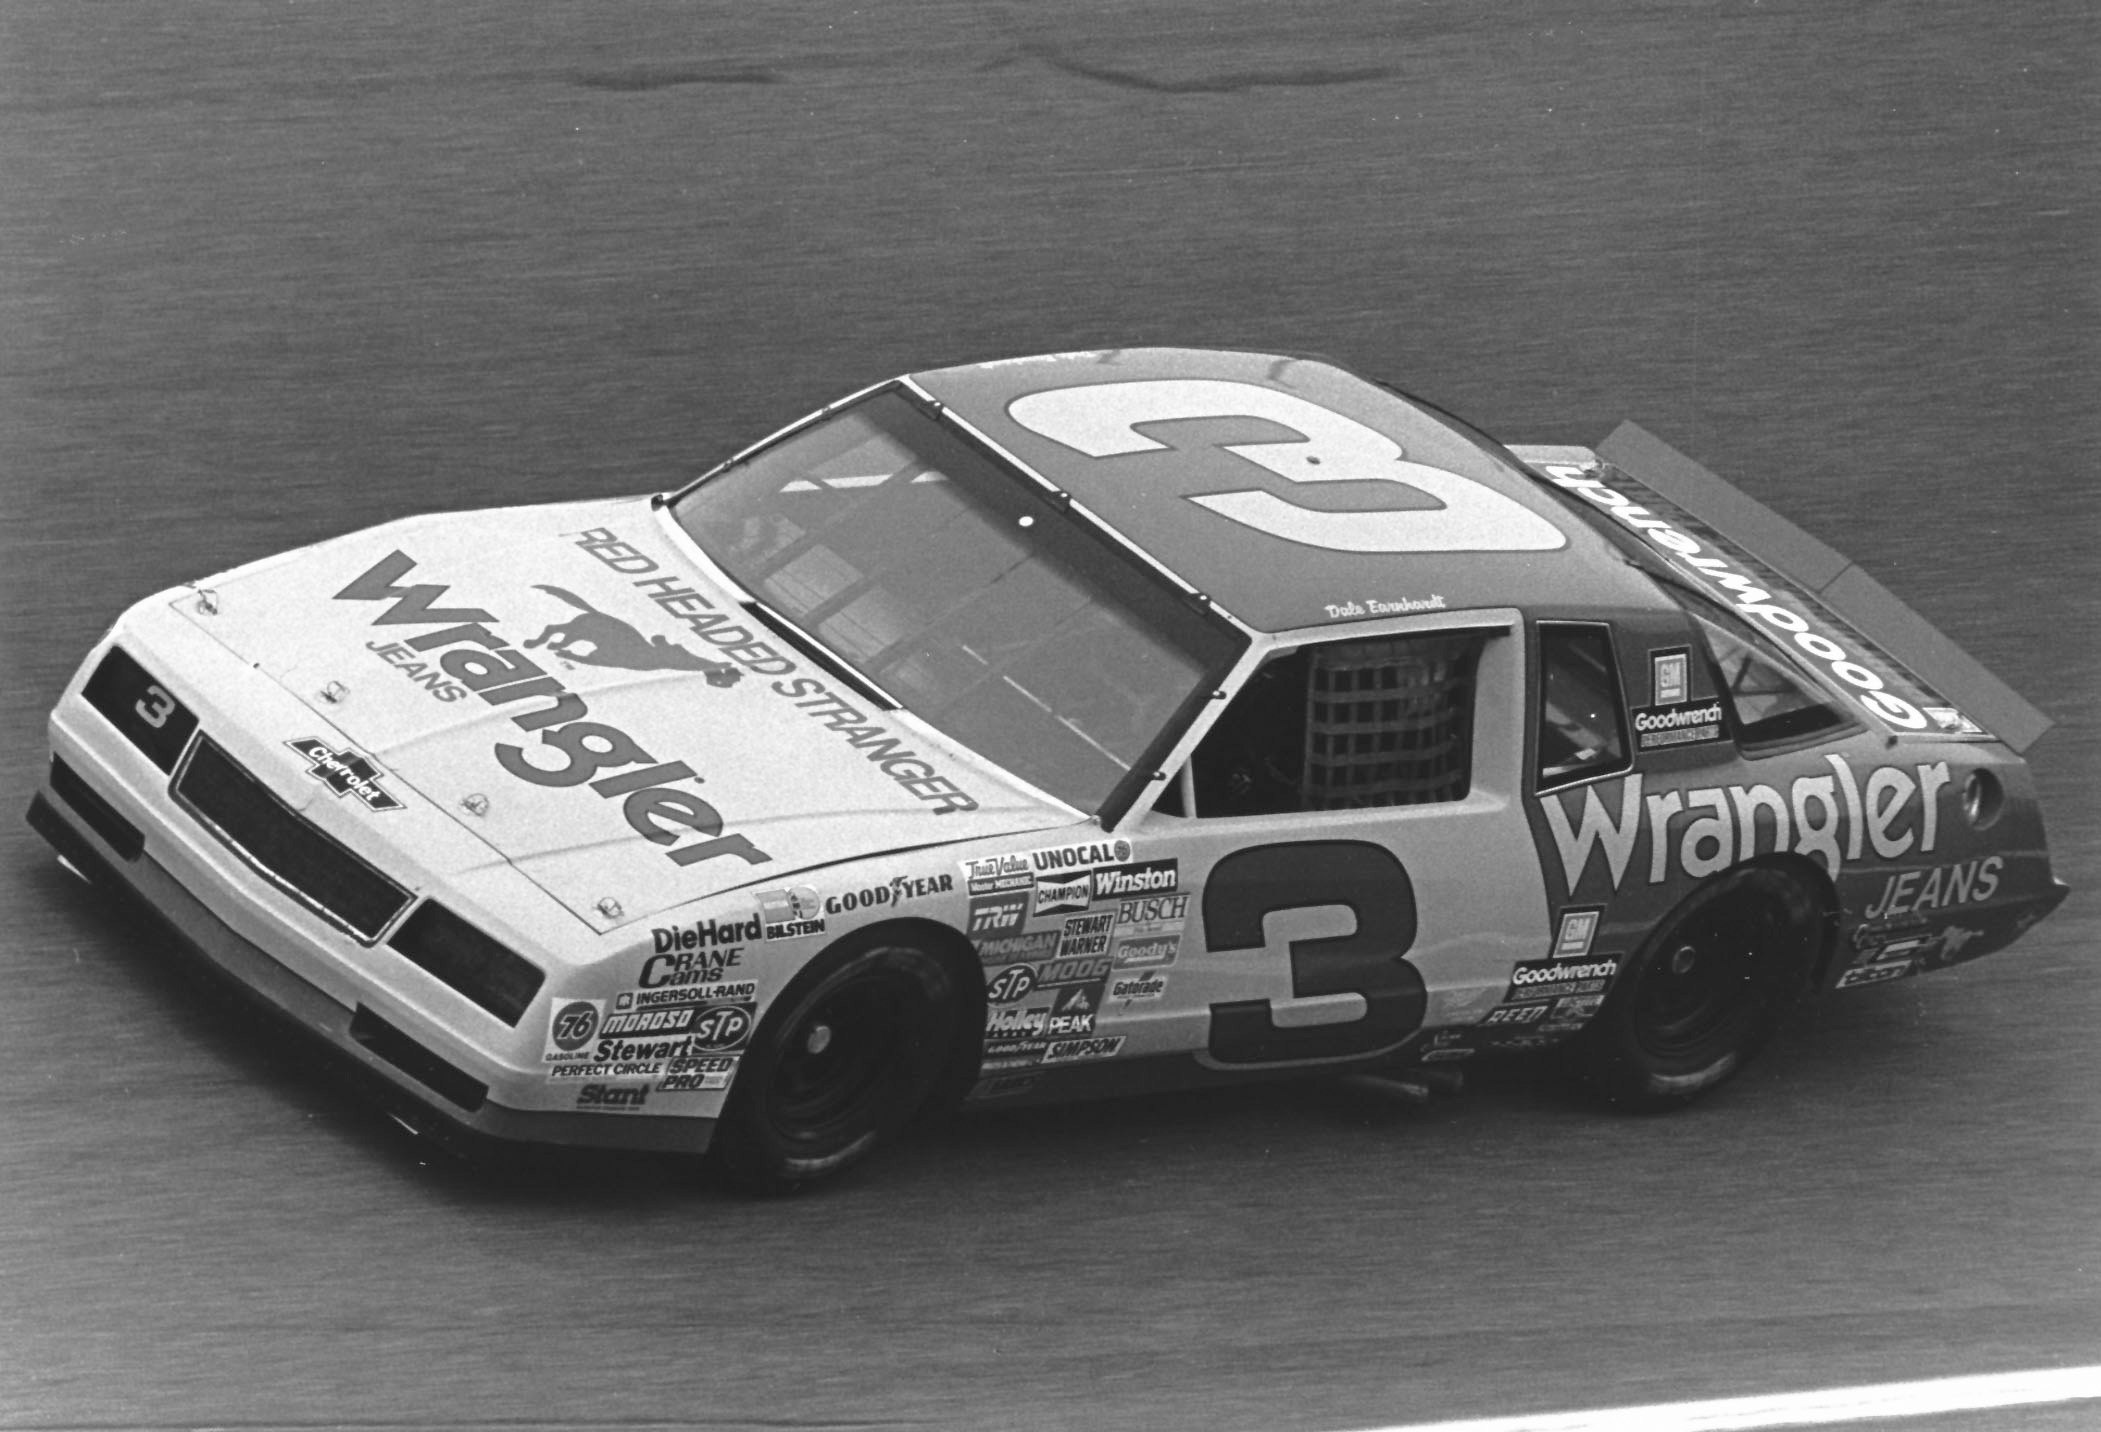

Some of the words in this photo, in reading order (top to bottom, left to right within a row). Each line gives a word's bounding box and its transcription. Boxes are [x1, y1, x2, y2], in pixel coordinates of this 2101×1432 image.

[1006, 379, 1567, 552] 3
[1324, 601, 1366, 618] Dale
[1365, 594, 1447, 613] Earnhardt
[1545, 465, 1928, 730] Goodwrench
[365, 640, 468, 703] JEANS
[575, 527, 660, 574] RED
[632, 576, 797, 675] HEADED
[771, 678, 980, 816] STRANGER
[134, 684, 176, 729] 3
[331, 549, 773, 867] Wrangler
[1635, 703, 1722, 731] Goodwrench
[308, 746, 381, 801] Chevrolet
[1540, 754, 1952, 897] Wrangler
[965, 860, 995, 879] True
[986, 854, 1030, 877] Value
[1032, 843, 1114, 870] UNOCAL
[825, 873, 954, 914] GOODYEAR
[1038, 884, 1090, 904] CHAMPION
[1095, 867, 1177, 895] Winston
[1865, 856, 2004, 919] JEANS
[972, 903, 1024, 931] TRW
[1117, 897, 1188, 924] BUSCH
[651, 913, 763, 953] DieHard
[766, 919, 826, 939] BILSTEIN
[1063, 914, 1113, 937] STEWART
[979, 932, 1057, 957] MICHIGAN
[1060, 935, 1107, 957] WARNER
[1117, 941, 1177, 963] Goody's
[1201, 838, 1428, 1064] 3
[638, 948, 745, 989] CRANE
[1037, 958, 1113, 982] MOOG
[1512, 960, 1617, 985] Goodwrench
[636, 983, 756, 1005] INGERSOLL-RAND
[988, 968, 1031, 1000] STP
[1113, 979, 1164, 996] Gatorade
[556, 1010, 595, 1040] 76
[601, 1010, 695, 1034] MOROSO
[697, 1011, 744, 1041] STP
[985, 1010, 1048, 1036] Holley
[1048, 1013, 1095, 1035] PEAK
[593, 1035, 694, 1061] Stewart
[1050, 1038, 1122, 1058] SIMPSON
[552, 1063, 613, 1077] PERFECT
[613, 1062, 663, 1075] CIRCLE
[669, 1057, 735, 1074] SPEED
[576, 1083, 650, 1105] Stant
[662, 1074, 705, 1089] PRO
